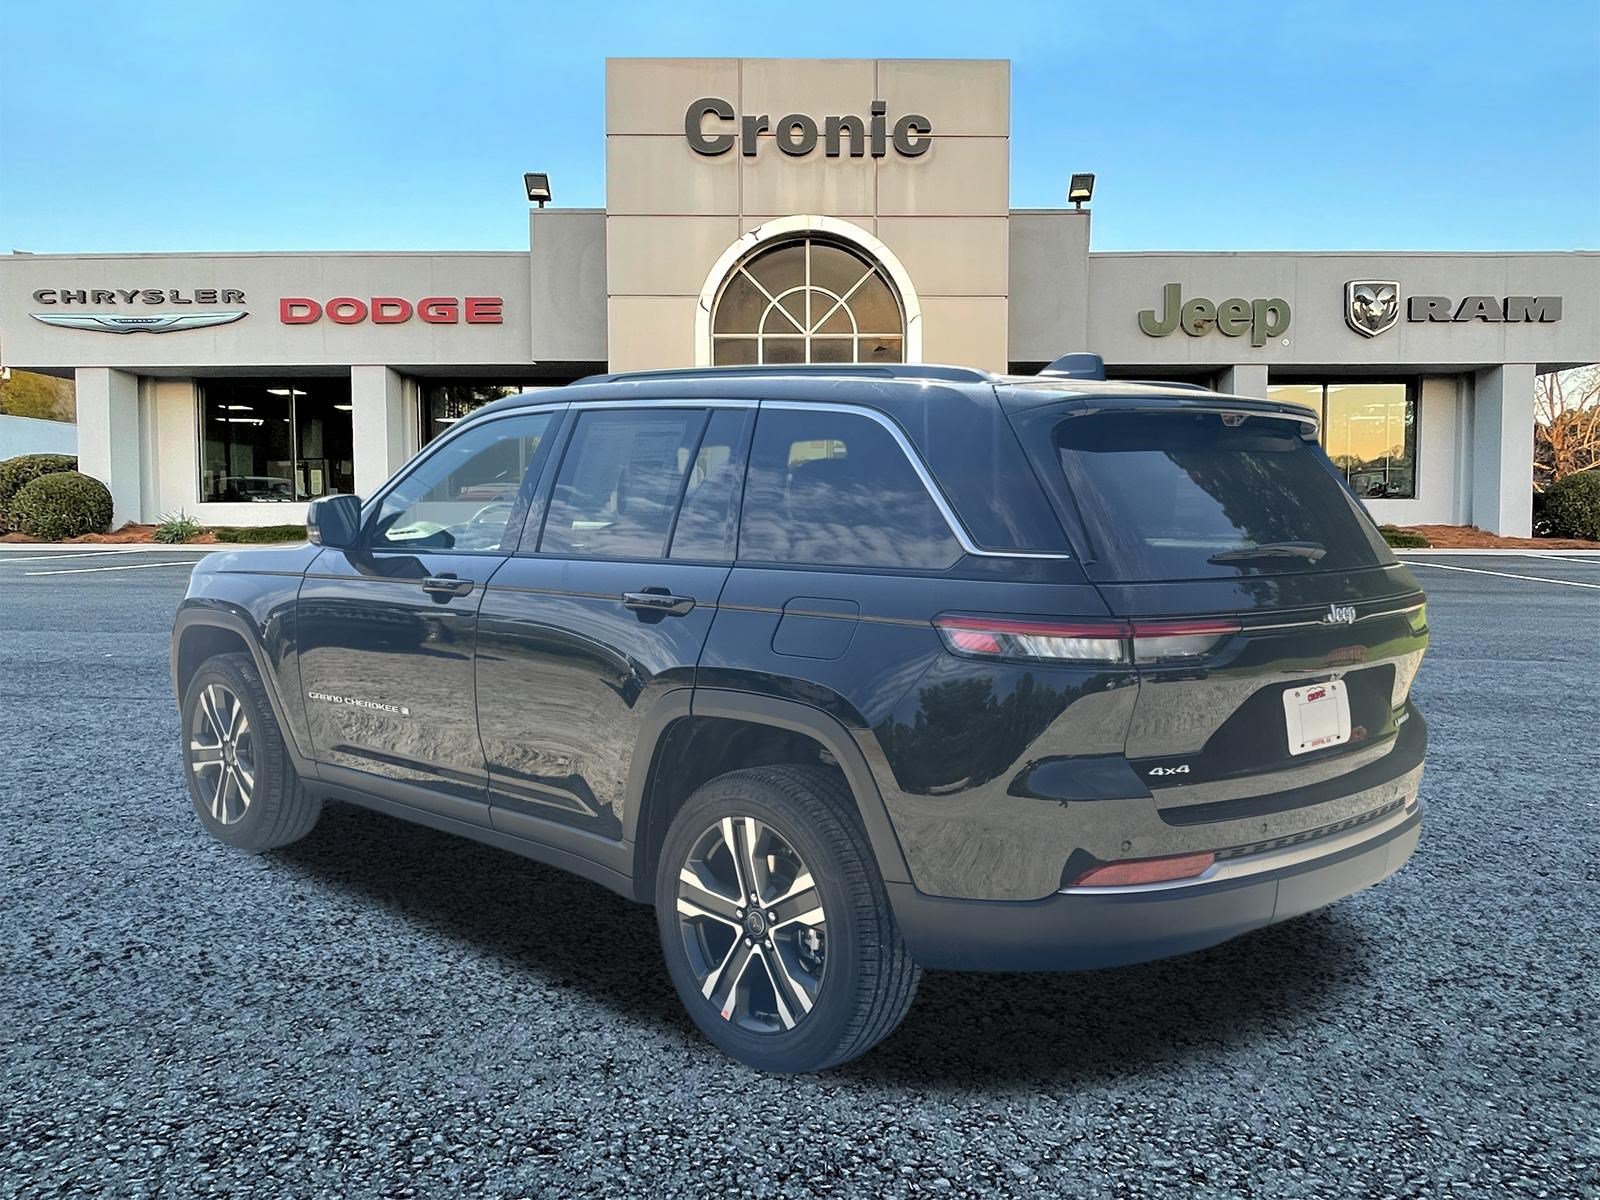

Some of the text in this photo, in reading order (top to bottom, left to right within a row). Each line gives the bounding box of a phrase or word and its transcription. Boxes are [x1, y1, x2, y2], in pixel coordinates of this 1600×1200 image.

[685, 97, 932, 157] Cronic
[32, 288, 246, 304] CHRYSLER
[279, 296, 504, 325] DODGE
[1138, 282, 1292, 347] Jeep
[1406, 295, 1563, 323] RAM
[1328, 603, 1356, 624] Jeep
[309, 691, 400, 713] GRAND CHEROKEE
[1148, 764, 1190, 776] 4x4
